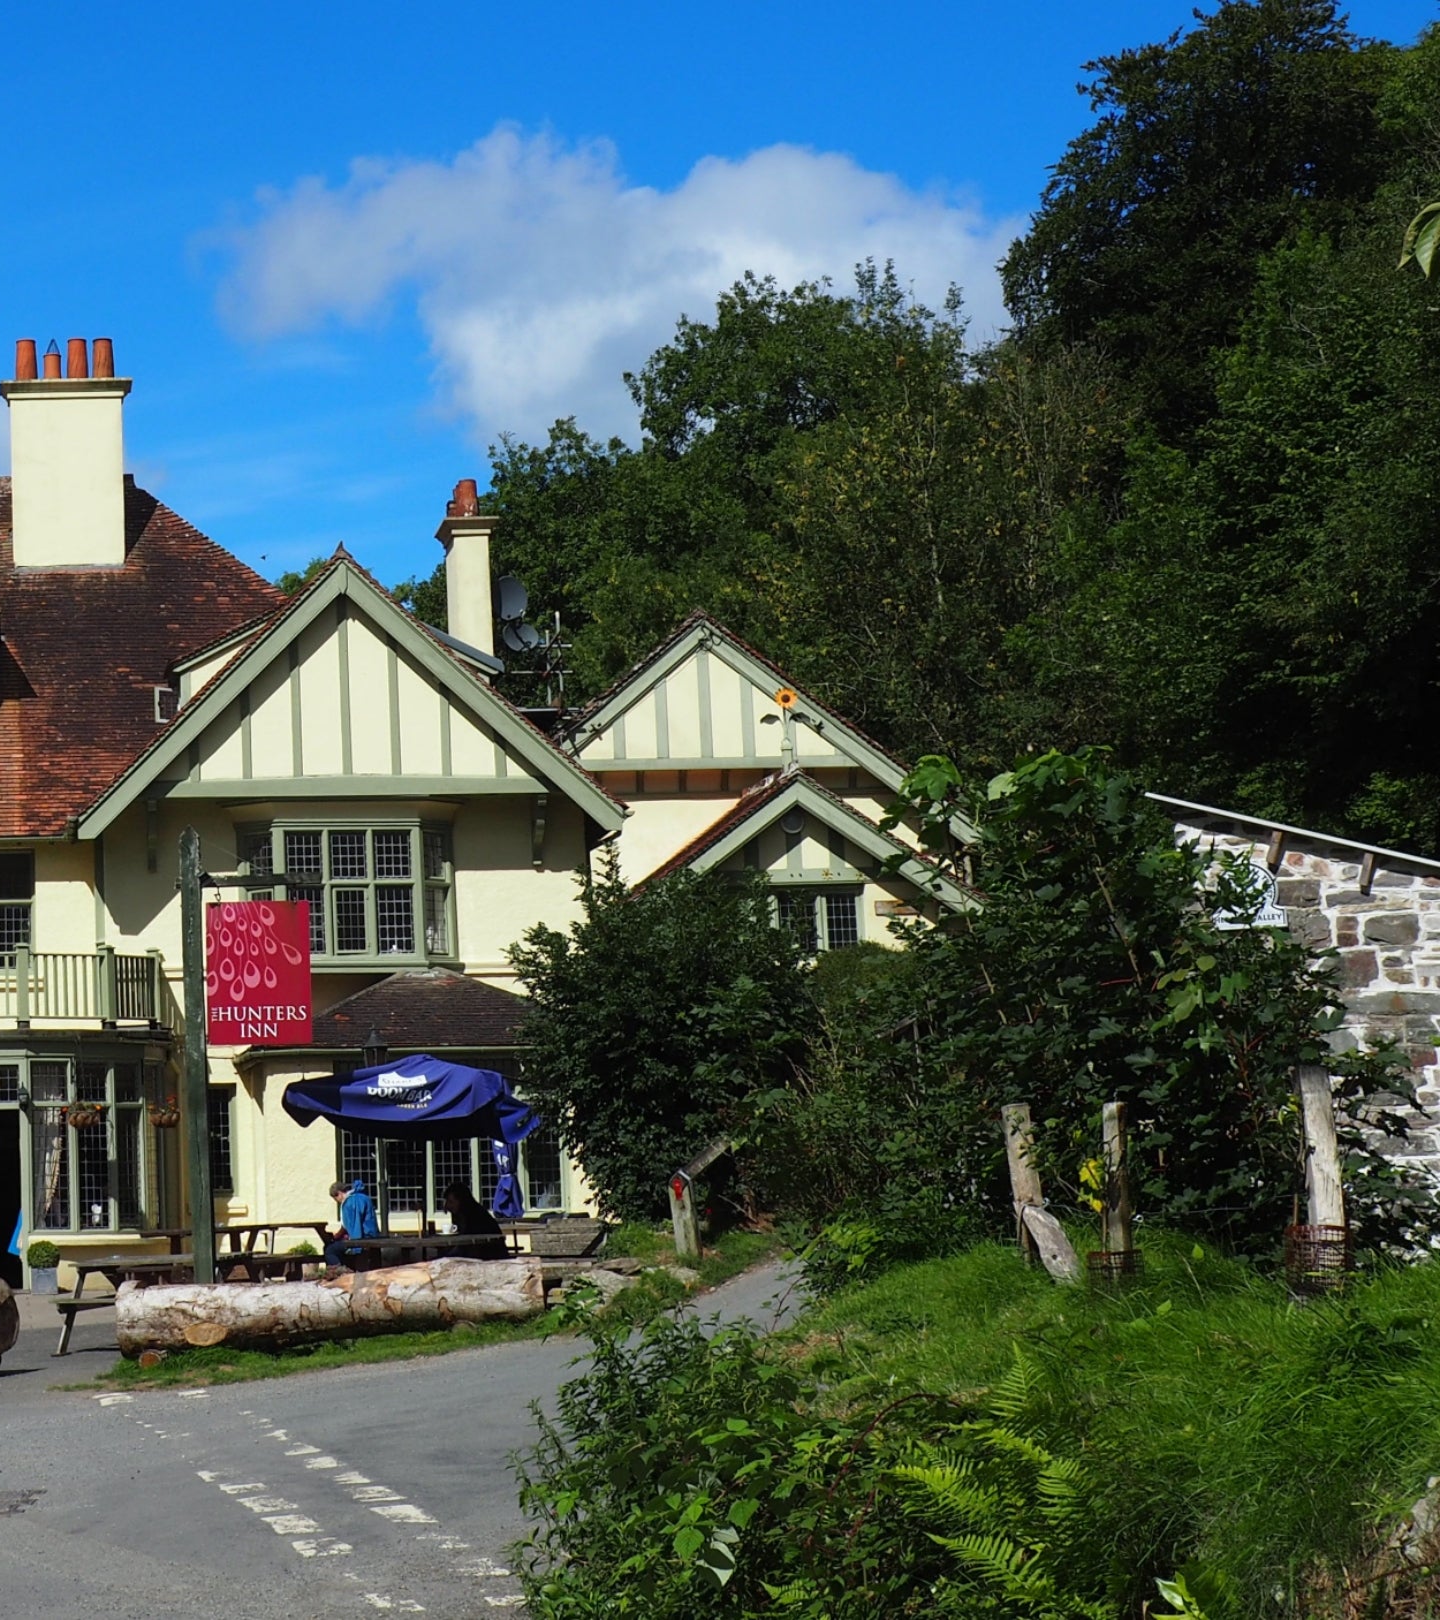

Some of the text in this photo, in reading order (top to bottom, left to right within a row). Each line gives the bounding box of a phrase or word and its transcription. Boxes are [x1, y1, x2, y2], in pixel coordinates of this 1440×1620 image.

[1256, 913, 1282, 921] ALLEY
[218, 1005, 307, 1022] HUNTERS
[240, 1022, 278, 1038] INN
